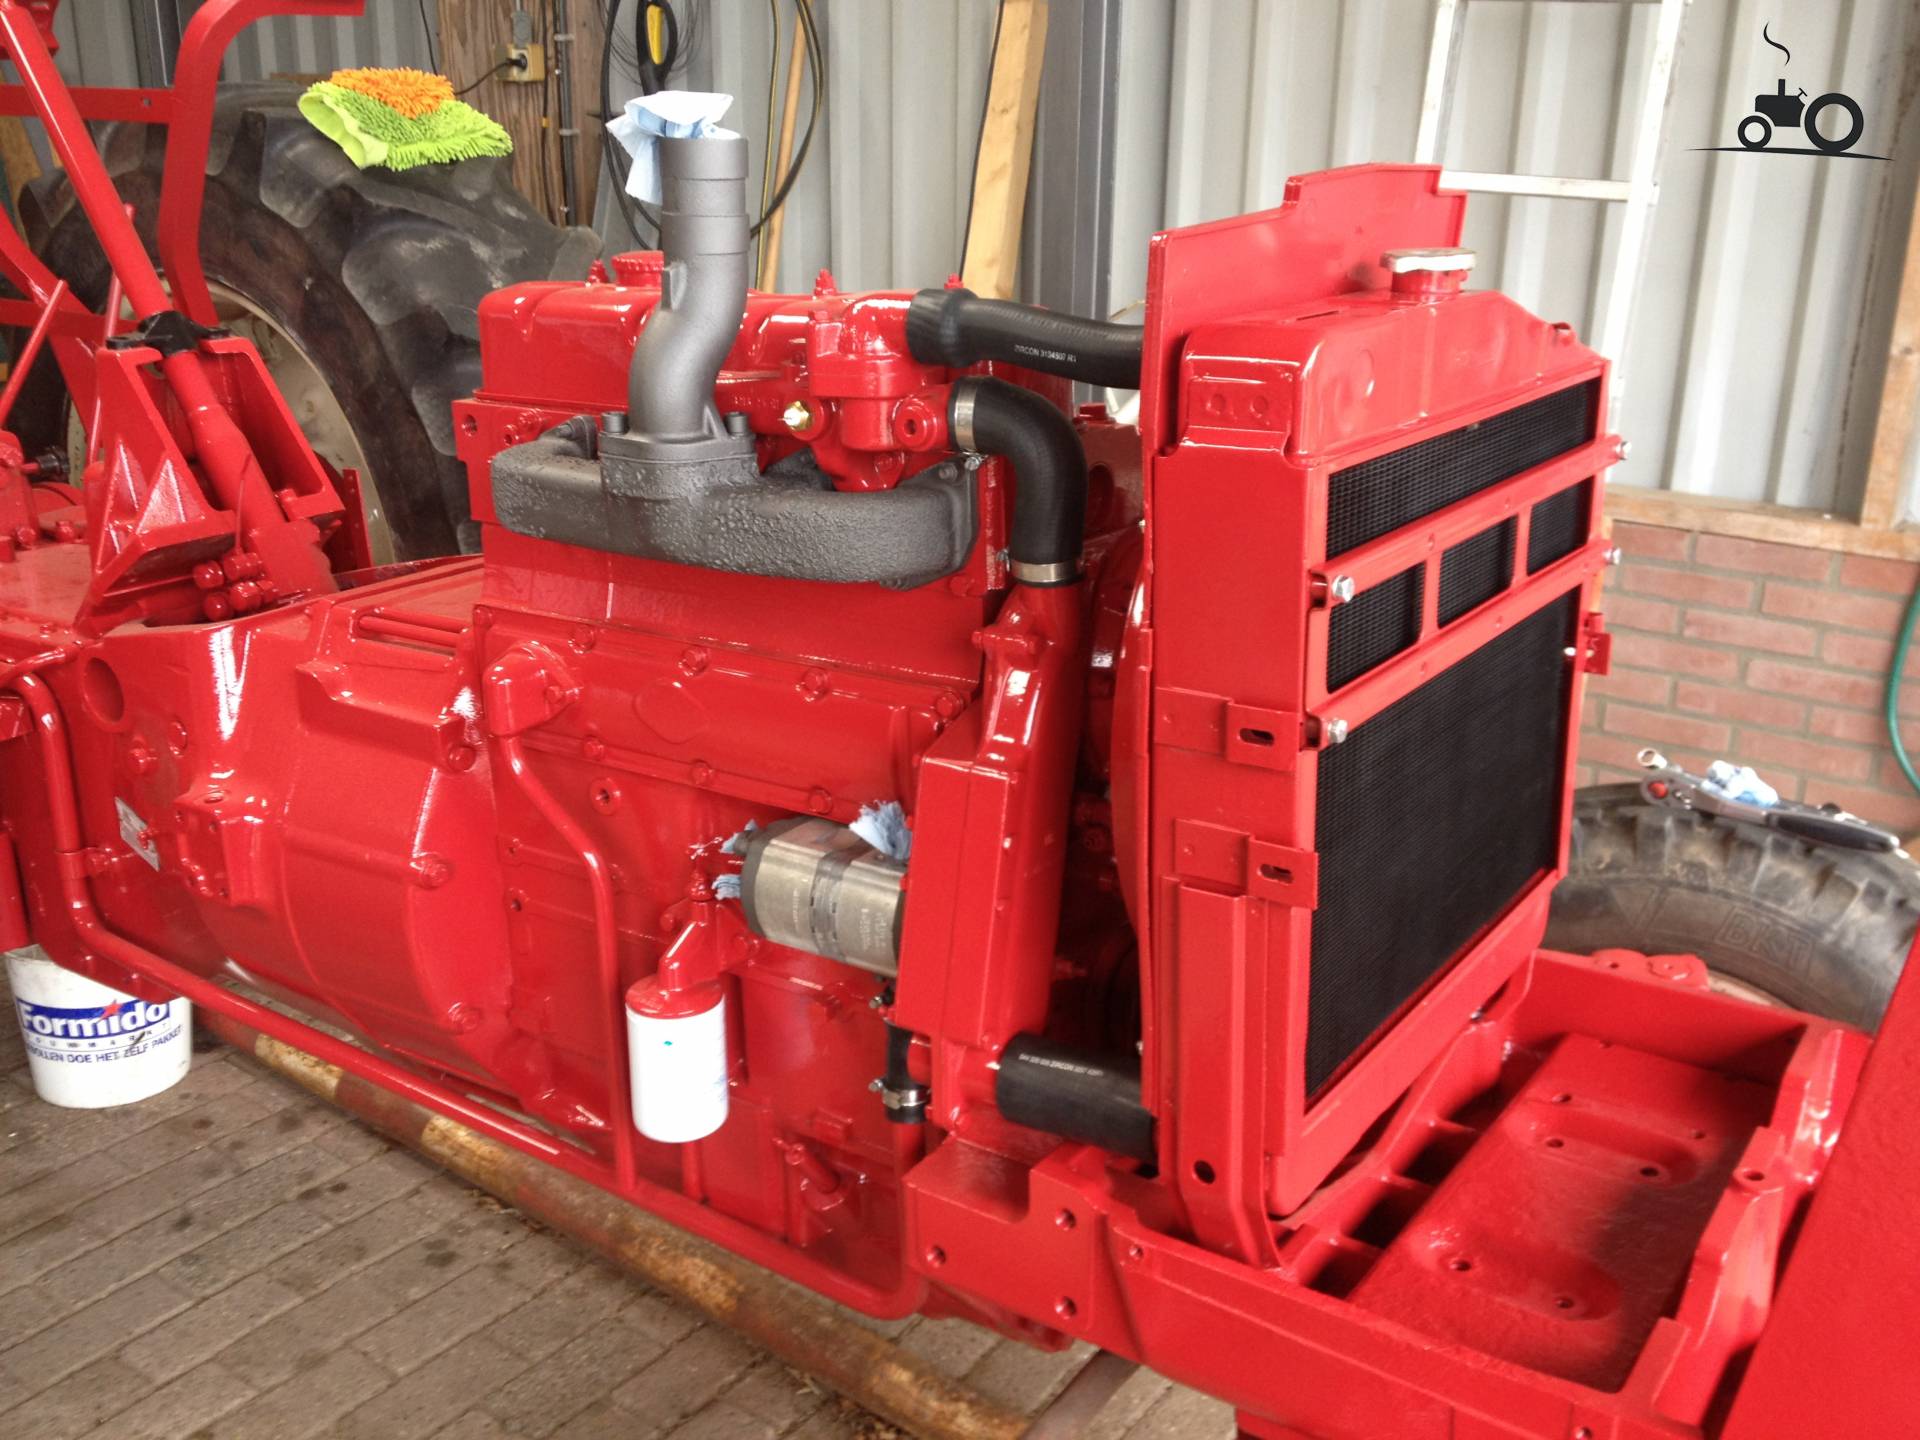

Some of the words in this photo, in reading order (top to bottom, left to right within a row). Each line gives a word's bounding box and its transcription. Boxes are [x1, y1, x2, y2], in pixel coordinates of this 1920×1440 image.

[18, 999, 169, 1036] Formido
[66, 1053, 93, 1064] DOE
[96, 1051, 119, 1062] HET
[123, 1042, 149, 1059] ZELF
